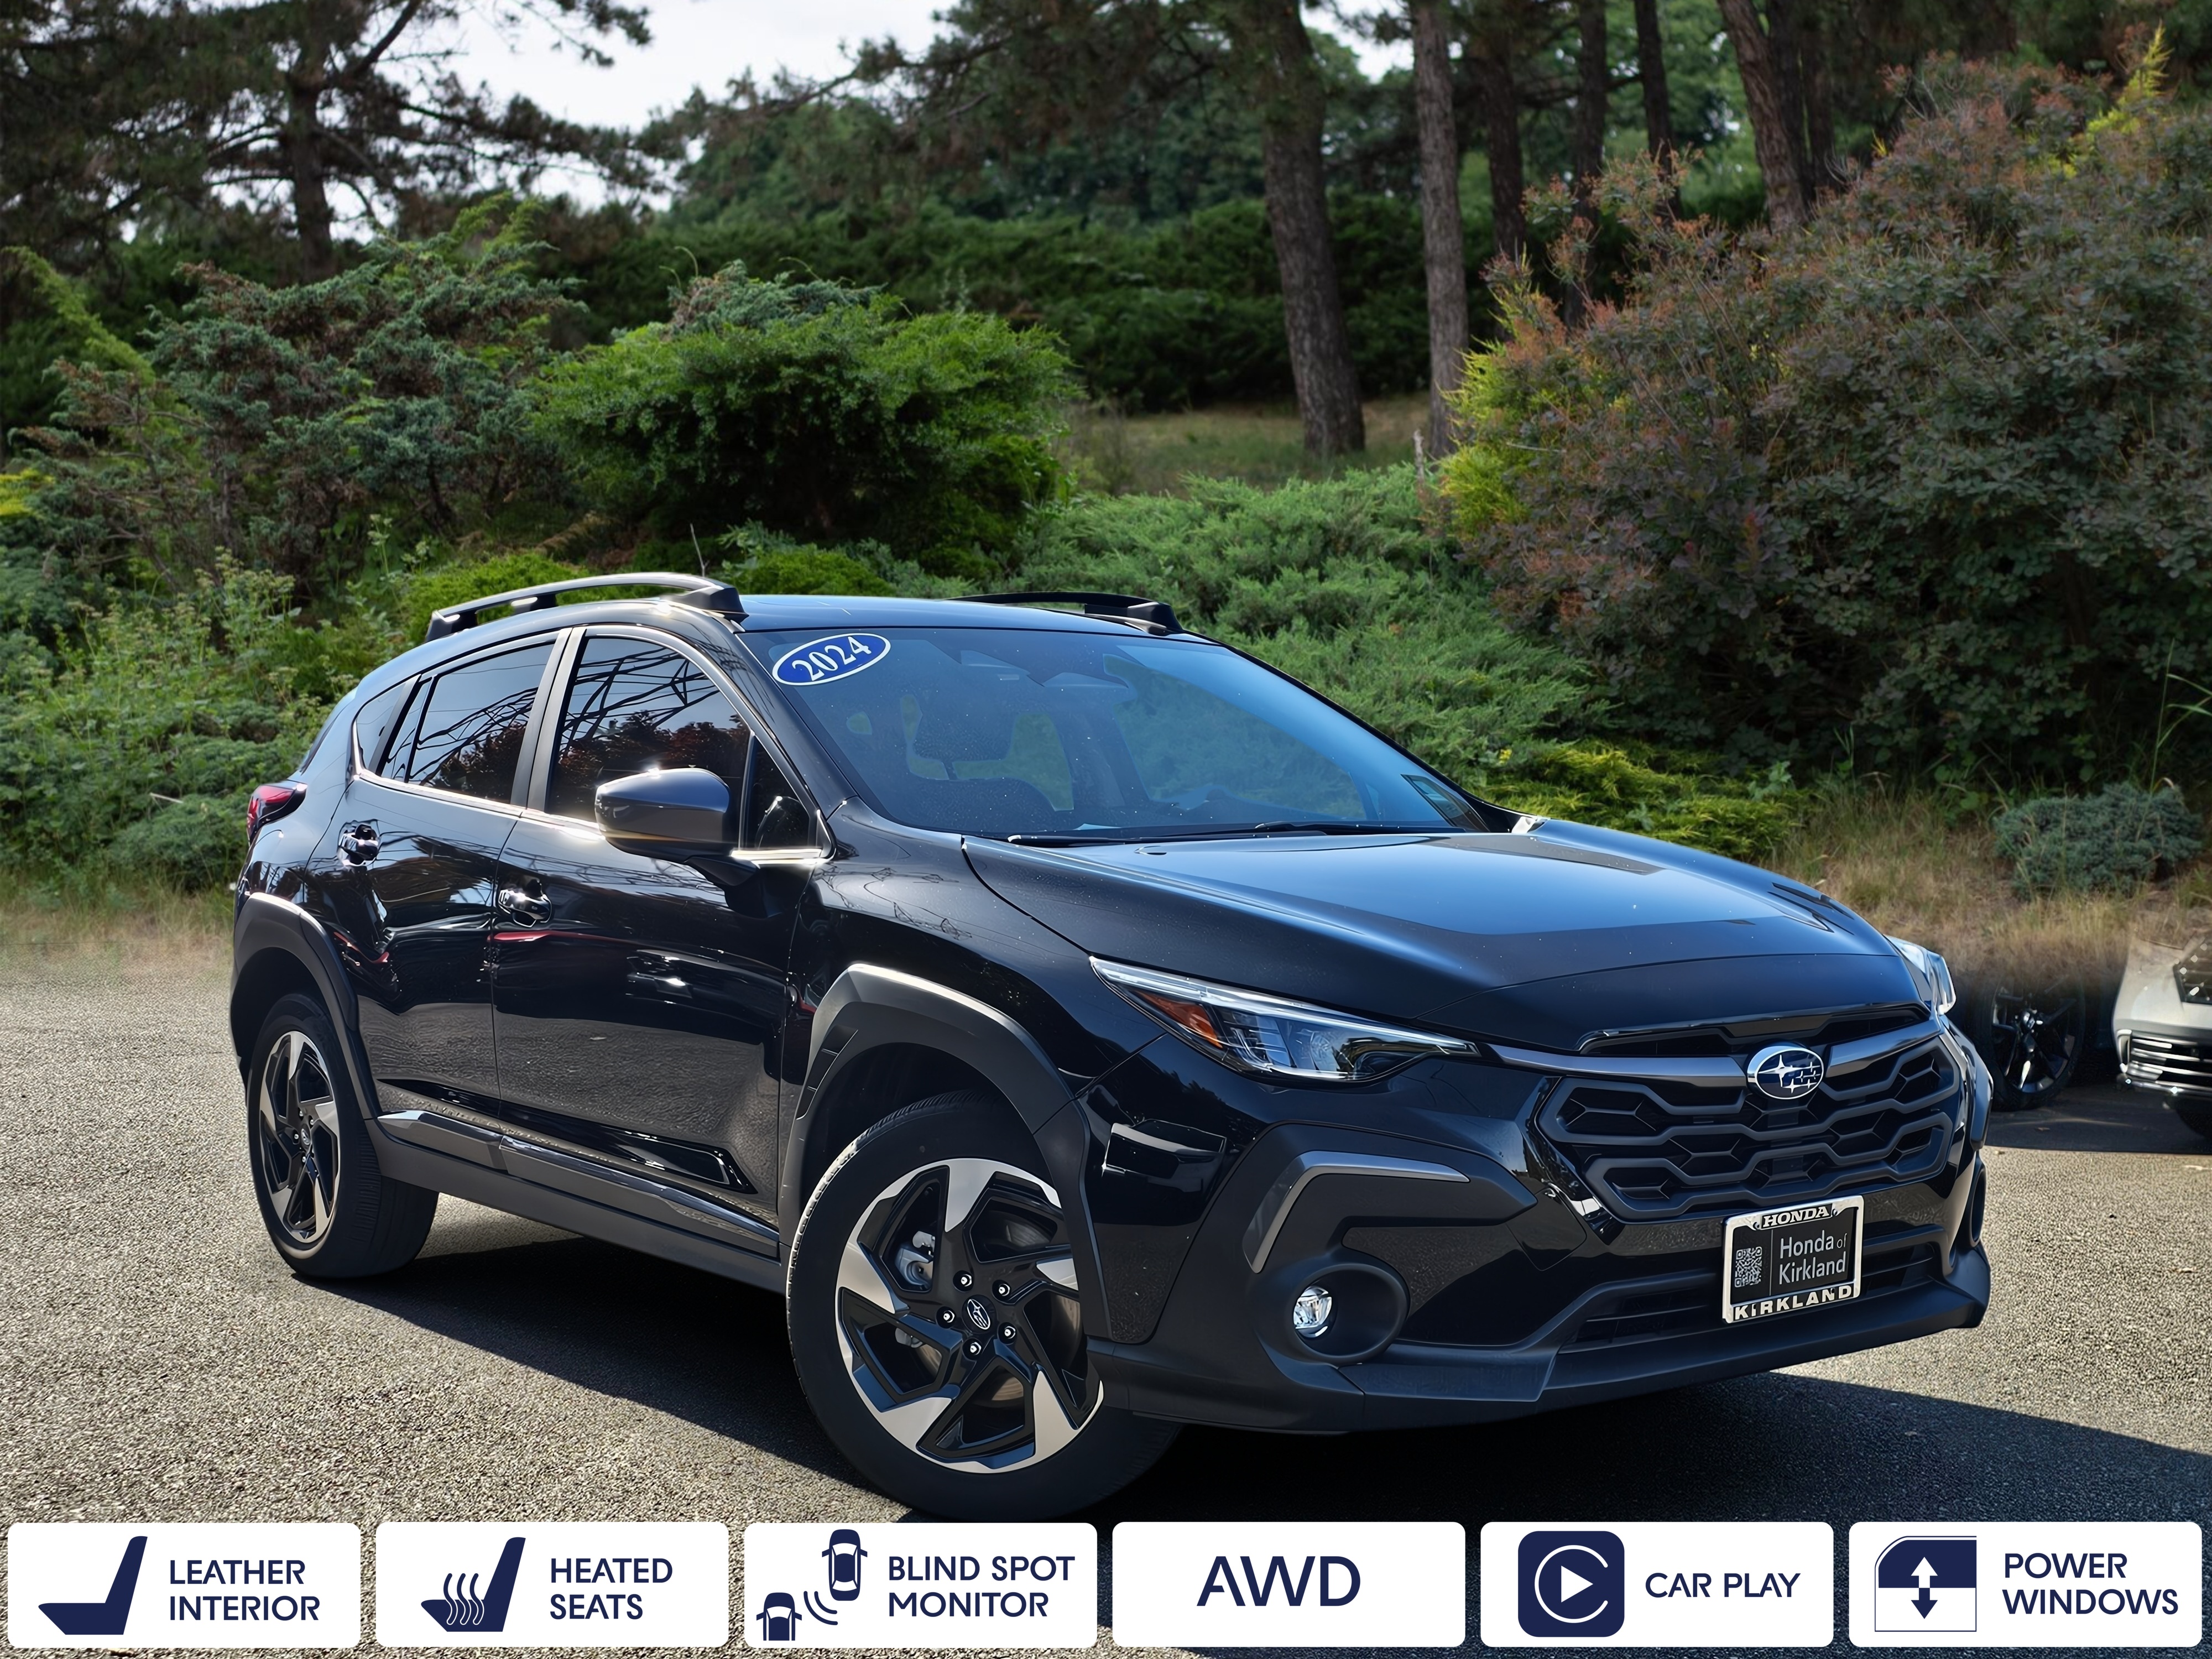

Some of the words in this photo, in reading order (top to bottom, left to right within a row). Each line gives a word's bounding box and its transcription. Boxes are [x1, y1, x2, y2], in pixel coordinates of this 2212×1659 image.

[791, 635, 872, 681] 2024
[1762, 1206, 1830, 1228] HONDA
[1780, 1229, 1834, 1259] Honda
[1836, 1233, 1848, 1249] of
[1778, 1251, 1846, 1285] Kirkland
[1734, 1284, 1853, 1321] KIRKLAND
